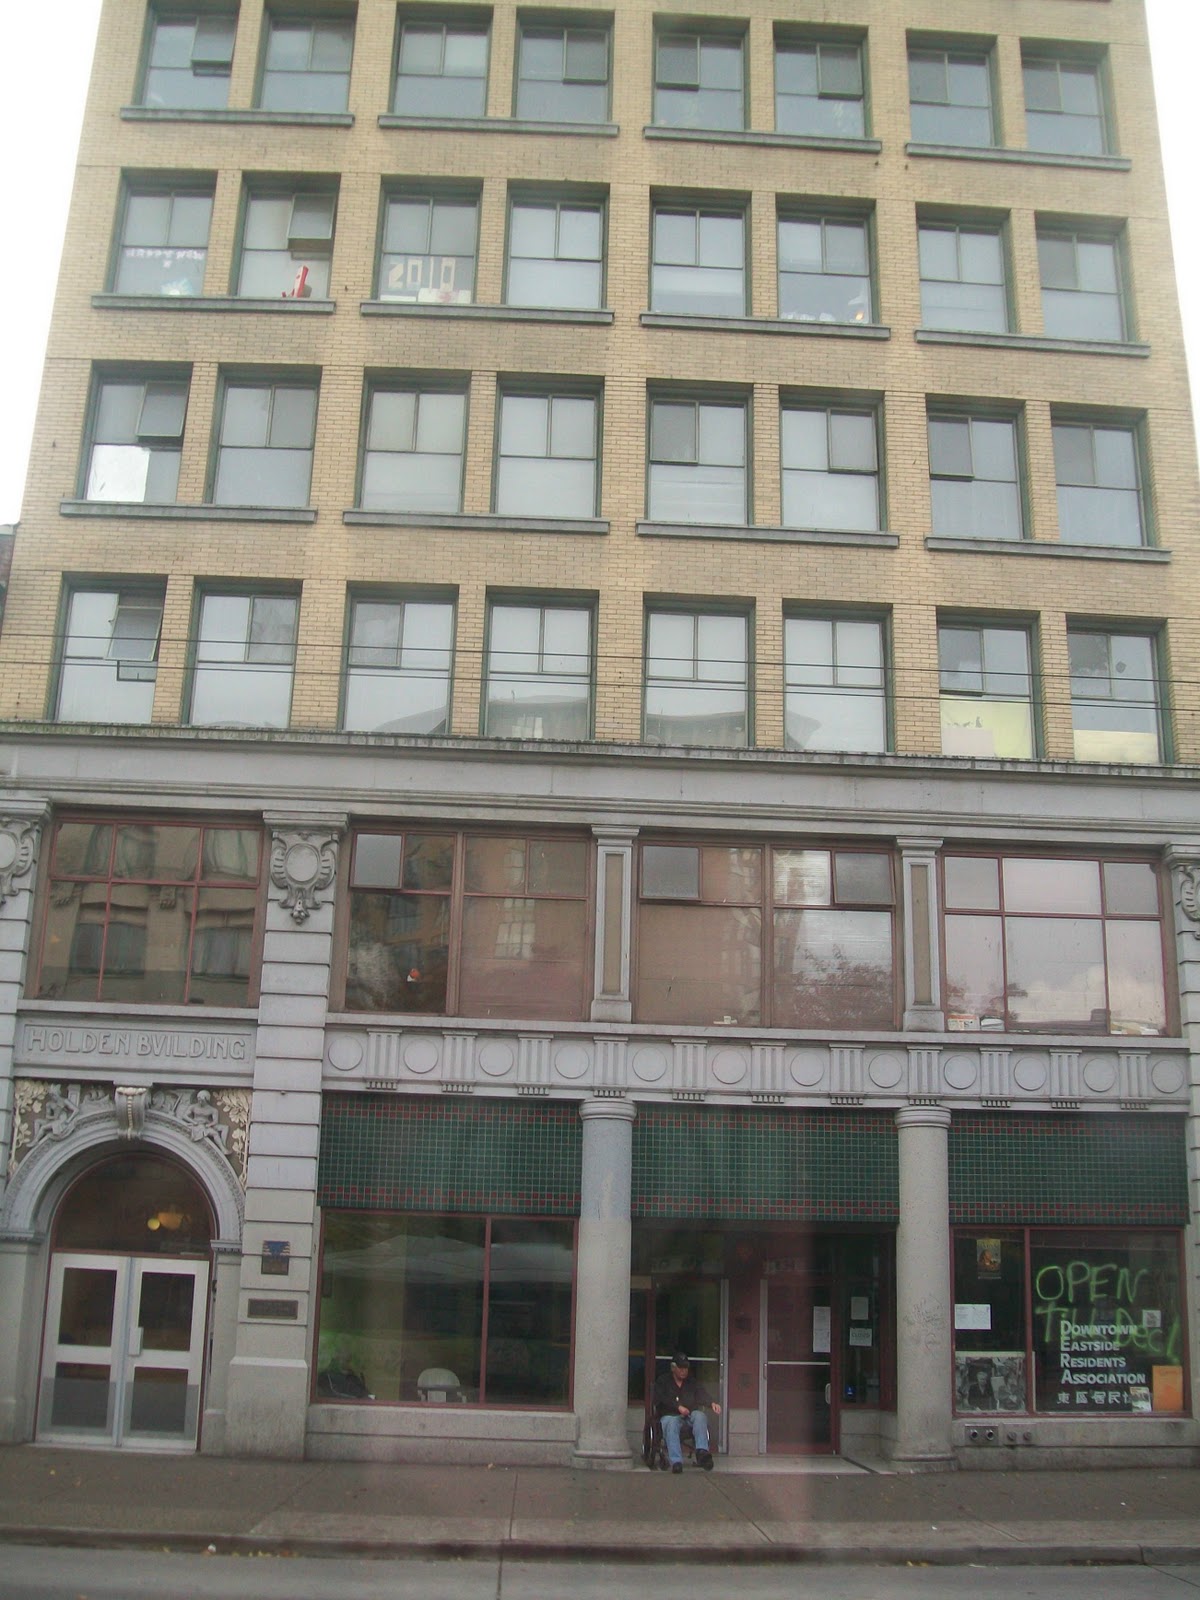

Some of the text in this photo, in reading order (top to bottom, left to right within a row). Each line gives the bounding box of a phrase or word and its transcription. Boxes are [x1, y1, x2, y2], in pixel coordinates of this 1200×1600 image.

[388, 256, 456, 292] 2010
[27, 1029, 132, 1056] HOLDEN
[1036, 1261, 1150, 1303] OPEN
[1060, 1320, 1138, 1336] DOWNTOWN
[1060, 1336, 1121, 1352] EASTSIDE
[1060, 1353, 1127, 1368] RESIDENTS
[1061, 1369, 1146, 1385] ASSOCIATION
